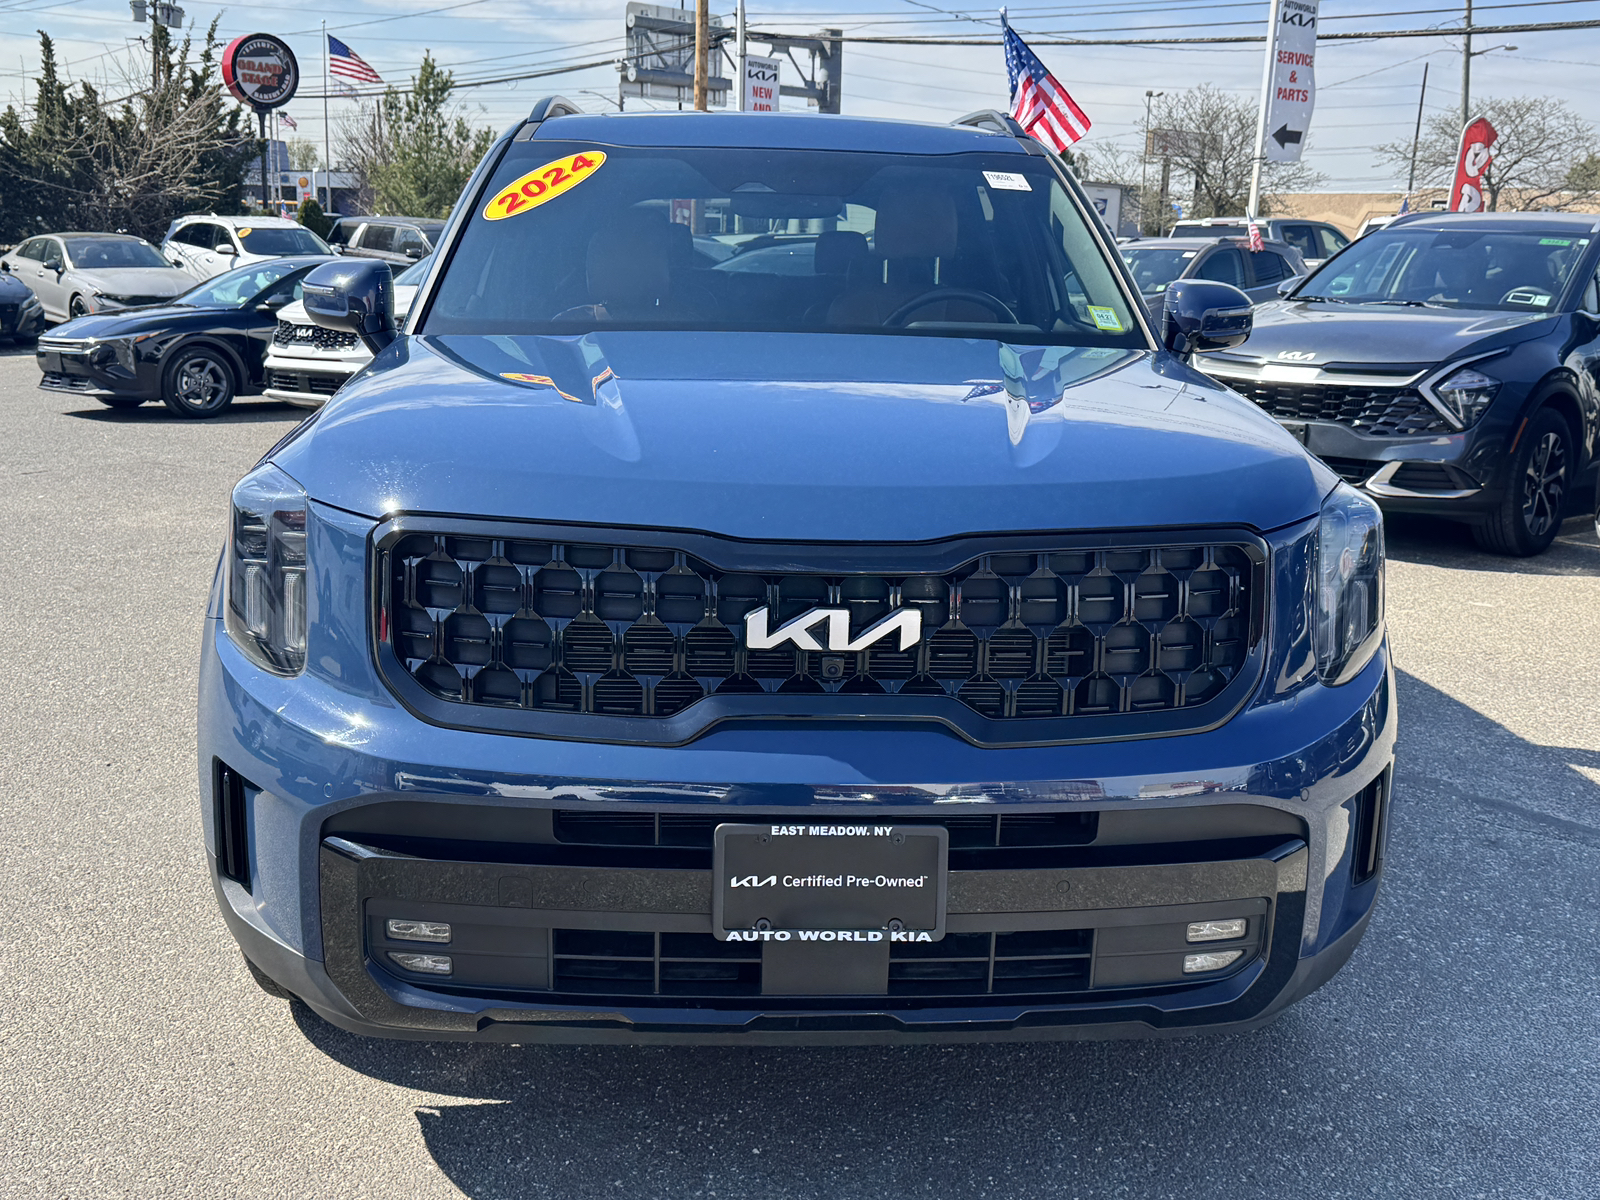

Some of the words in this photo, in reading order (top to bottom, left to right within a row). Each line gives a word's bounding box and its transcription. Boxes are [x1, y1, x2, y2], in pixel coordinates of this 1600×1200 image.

[1284, 0, 1316, 14] AUTOWORLD
[1282, 11, 1315, 29] KIA
[748, 60, 778, 71] AUTOWORLD
[1277, 50, 1314, 68] SERVICE
[238, 60, 282, 74] GRAND
[241, 73, 278, 87] STAGE
[748, 69, 777, 82] KIA
[1289, 70, 1298, 83] &
[752, 86, 773, 100] NEW
[1277, 87, 1308, 103] PARTS
[753, 102, 772, 112] AND
[498, 155, 595, 214] 2024
[296, 328, 313, 337] KIA
[1278, 350, 1317, 361] KIA
[744, 605, 922, 652] KIA
[771, 826, 805, 836] EAST
[874, 826, 893, 836] NY
[731, 875, 777, 887] KIA
[782, 875, 842, 887] Certified
[726, 931, 791, 941] AUTO
[798, 931, 883, 941] WORLD
[891, 931, 932, 942] KIA
